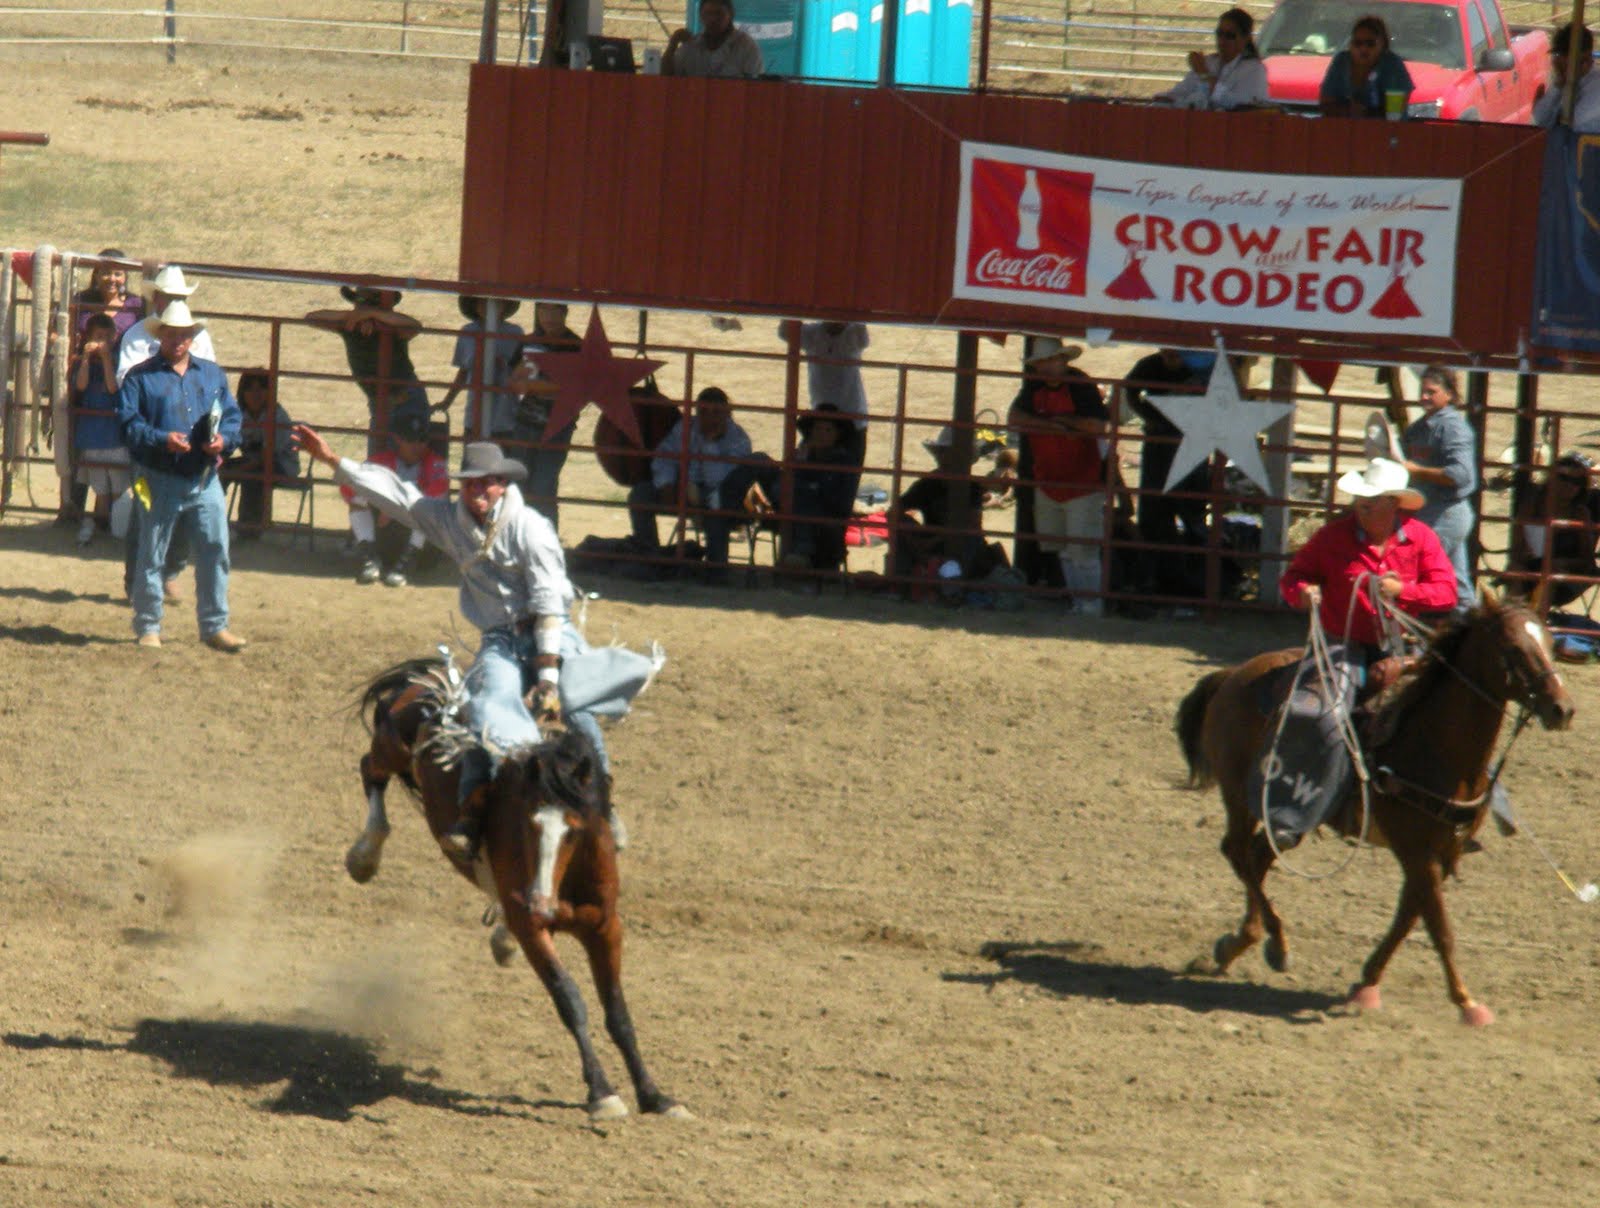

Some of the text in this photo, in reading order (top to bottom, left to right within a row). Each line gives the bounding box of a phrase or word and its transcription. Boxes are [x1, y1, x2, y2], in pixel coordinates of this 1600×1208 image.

[1187, 183, 1268, 211] Capital
[1275, 191, 1297, 217] of
[1303, 192, 1339, 209] the
[1350, 192, 1415, 212] World
[1114, 213, 1425, 267] CROW FAIR
[1255, 240, 1299, 266] and
[975, 248, 1076, 289] Coca-Cola
[1172, 264, 1364, 314] RODEO
